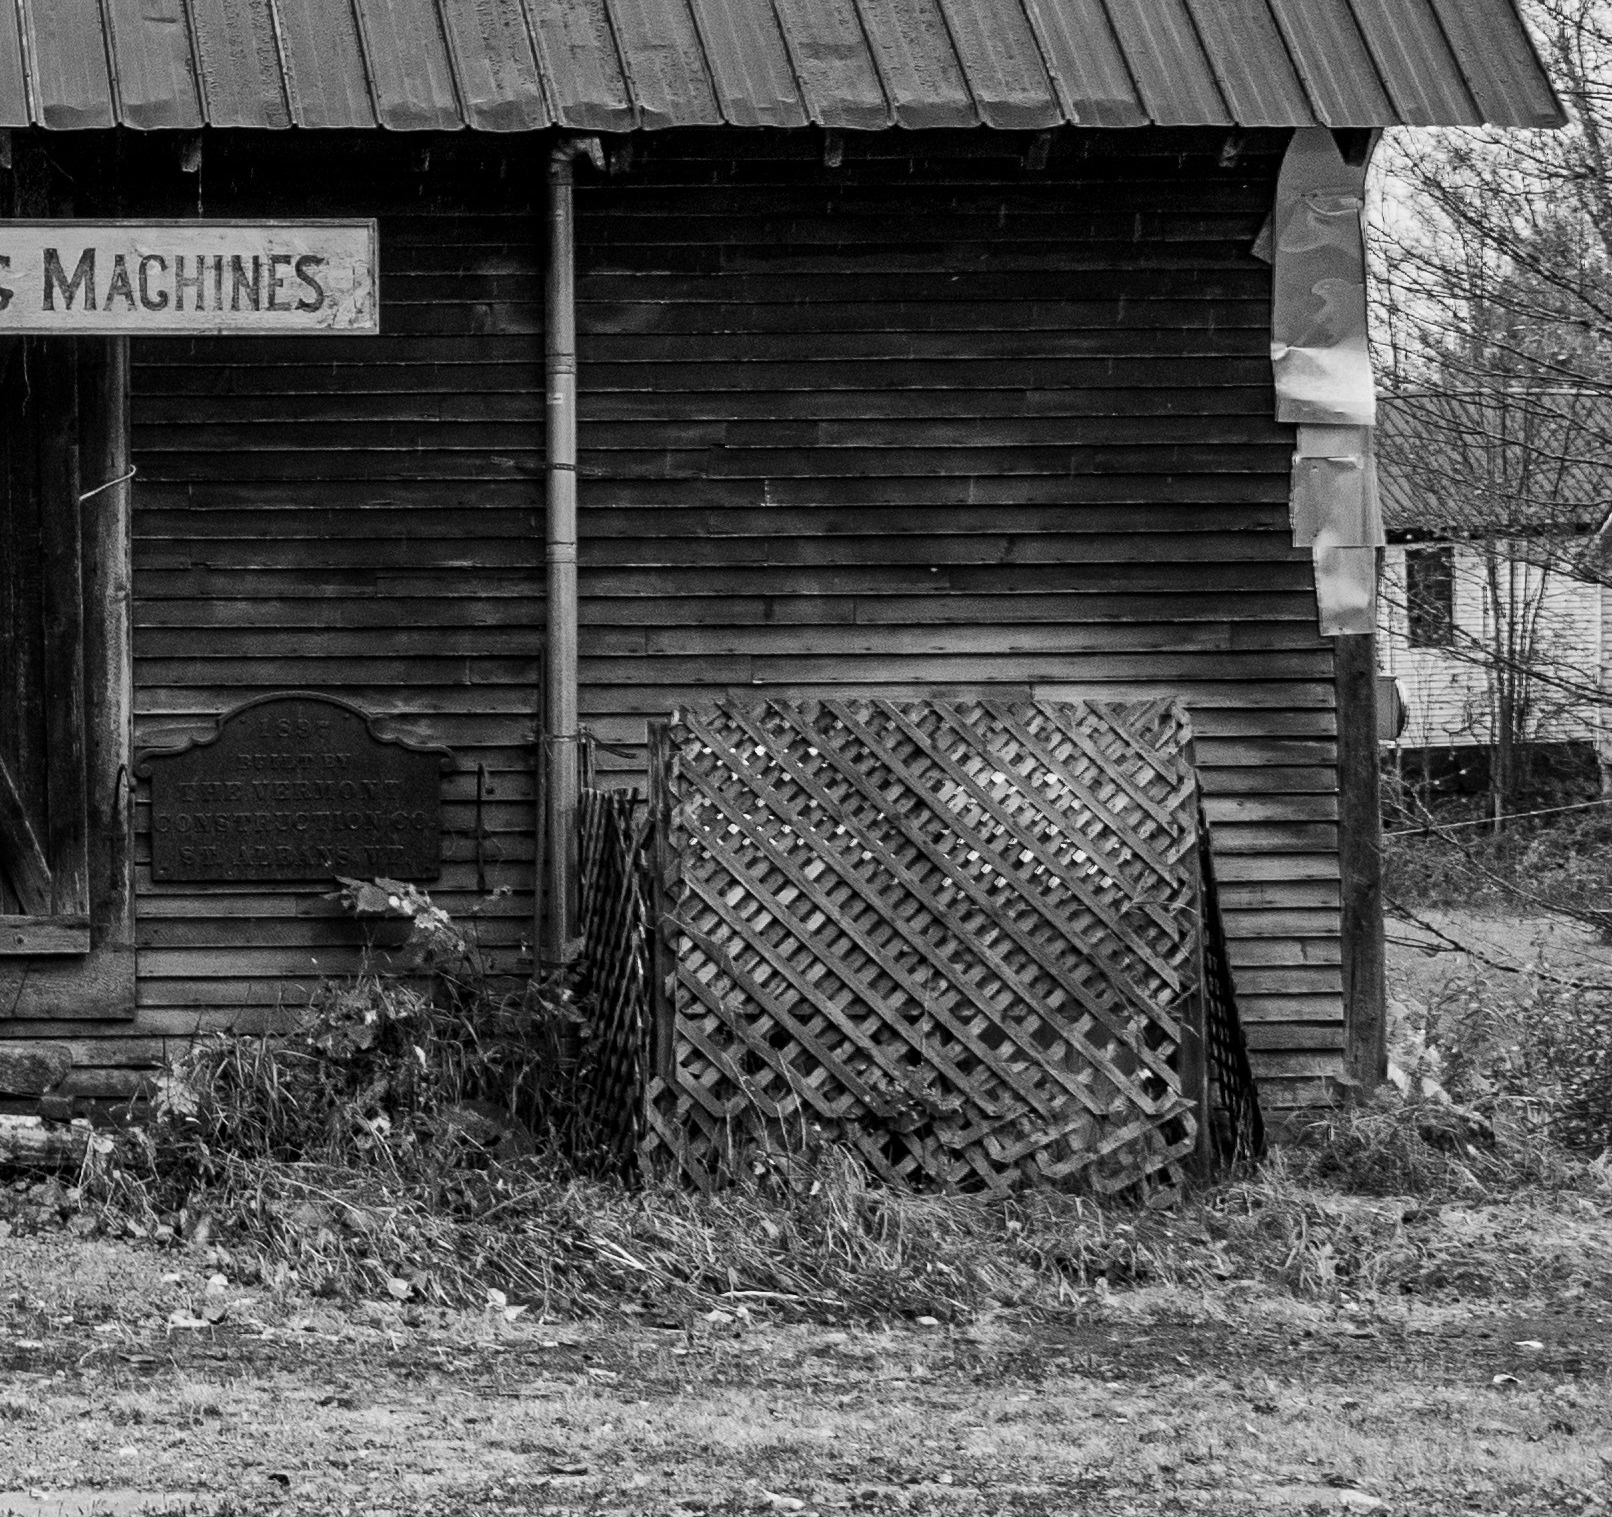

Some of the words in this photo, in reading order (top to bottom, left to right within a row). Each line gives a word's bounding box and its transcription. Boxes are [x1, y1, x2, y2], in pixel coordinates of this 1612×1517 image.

[237, 753, 314, 770] BUILT
[321, 752, 351, 770] BY
[176, 780, 243, 802] THE
[251, 779, 401, 801] VERMONT
[153, 810, 382, 833] CONSTRUCTION
[232, 844, 350, 867] ALBANS
